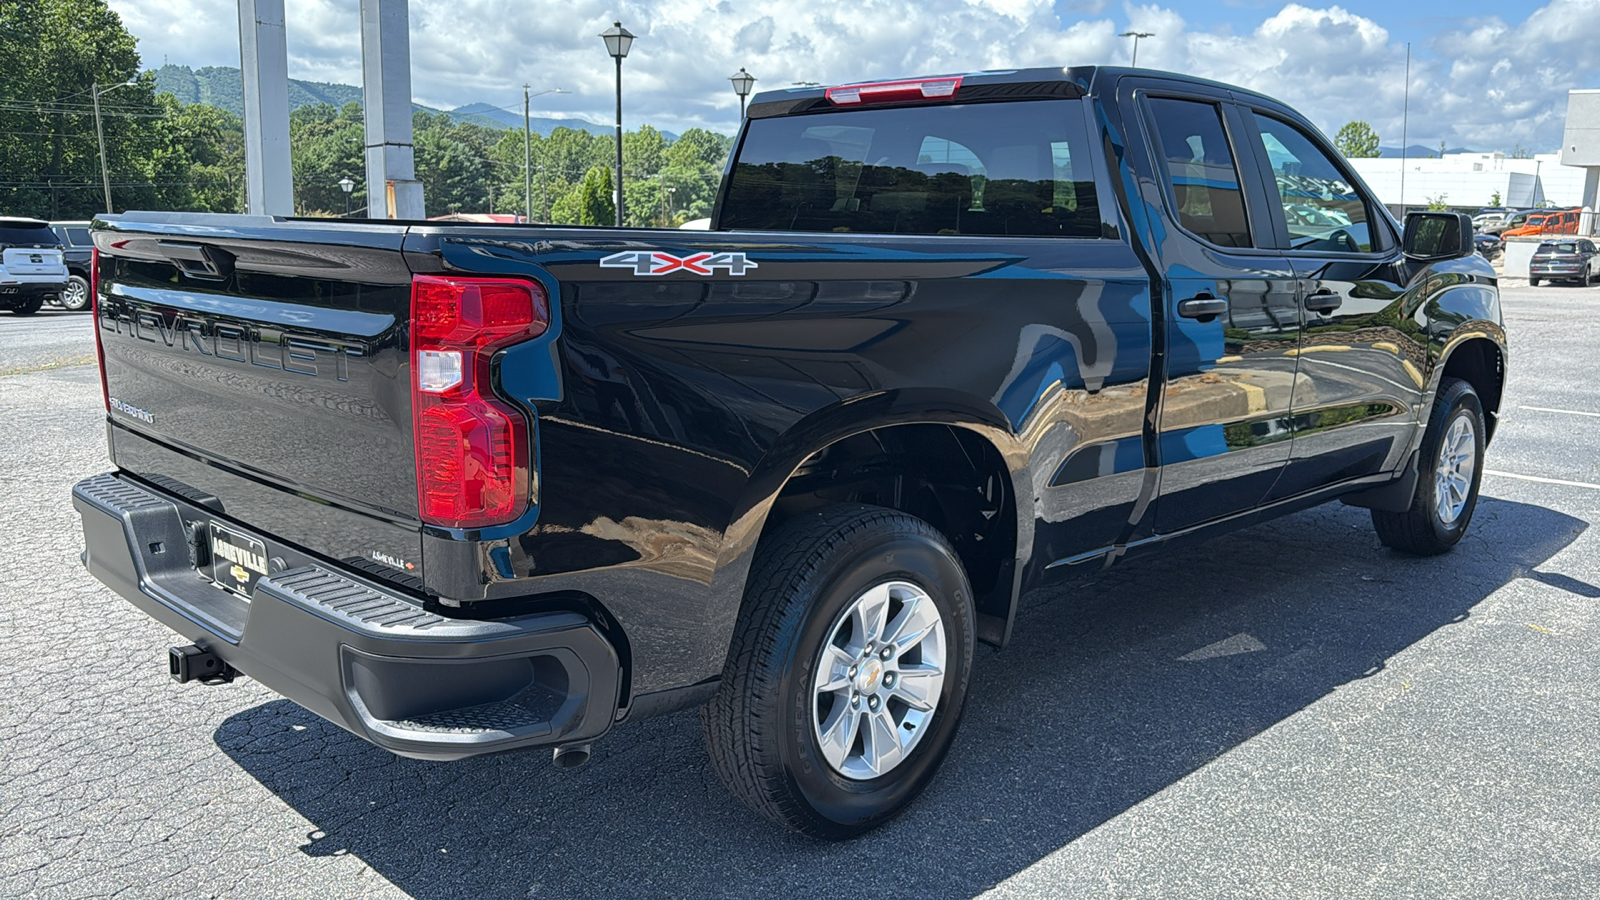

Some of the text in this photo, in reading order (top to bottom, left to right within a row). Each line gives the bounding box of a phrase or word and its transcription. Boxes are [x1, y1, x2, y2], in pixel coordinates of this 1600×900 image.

[599, 250, 759, 276] 4X4
[100, 299, 365, 382] CHEVROLET
[213, 536, 268, 576] ASHEVILLE
